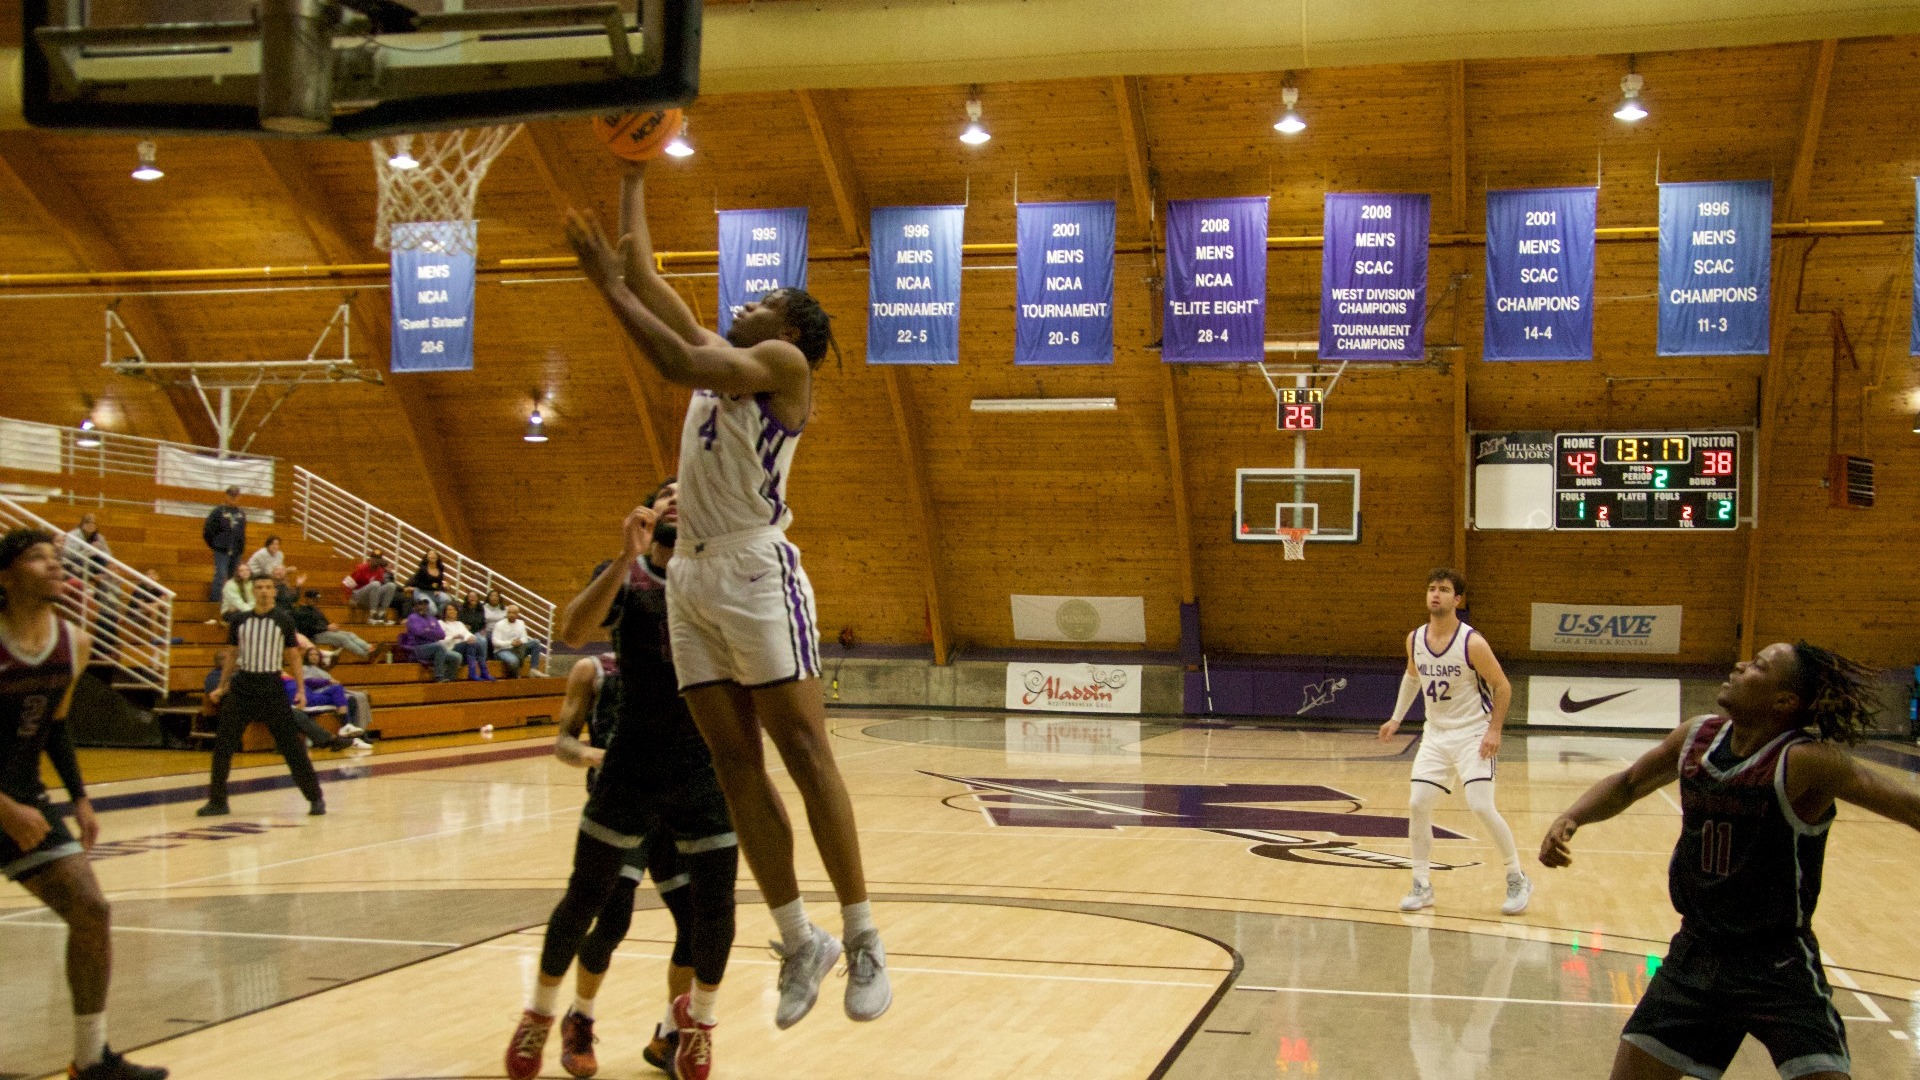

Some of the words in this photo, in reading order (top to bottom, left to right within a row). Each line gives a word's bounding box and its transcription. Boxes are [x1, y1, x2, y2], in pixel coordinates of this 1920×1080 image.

[1361, 205, 1392, 219] 2008
[1698, 201, 1730, 217] 1996
[1200, 218, 1230, 233] 2008
[1525, 211, 1556, 226] 2001
[751, 227, 777, 241] 1995
[903, 224, 930, 238] 1996
[1052, 223, 1080, 237] 2001
[1692, 229, 1736, 246] MEN'S
[1355, 232, 1396, 247] MEN'S
[1519, 239, 1561, 255] MEN'S
[745, 252, 781, 267] MEN'S
[896, 249, 934, 264] MEN'S
[1046, 248, 1085, 264] MEN'S
[1195, 245, 1235, 260] MEN'S
[417, 264, 451, 279] MEN'S
[1355, 260, 1394, 275] SCAC
[1694, 259, 1734, 275] SCAC
[1195, 273, 1233, 287] NCAA
[1520, 267, 1558, 283] SCAC
[745, 278, 779, 293] NCAA
[896, 276, 931, 290] NCAA
[1046, 276, 1083, 291] NCAA
[417, 290, 449, 304] NCAA
[1331, 288, 1364, 300] WEST
[1366, 288, 1415, 300] DIVISION
[1670, 286, 1758, 305] CHAMPIONS
[872, 302, 955, 317] TOURNAMENT
[1021, 302, 1108, 318] TOURNAMENT
[1169, 300, 1211, 316] "ELITE
[1214, 298, 1259, 314] EIGHT"
[1338, 302, 1407, 314] CHAMPIONS
[1497, 296, 1580, 312] CHAMPIONS
[1332, 324, 1411, 336] TOURNAMENT
[1523, 326, 1552, 340] 14-4
[420, 340, 445, 354] 20-6
[1336, 338, 1405, 350] CHAMPIONS
[1285, 406, 1314, 429] 26
[698, 405, 718, 451] 4
[1503, 443, 1554, 452] MILLSAPS
[1563, 438, 1595, 449] HOME
[1690, 437, 1735, 448] VISITOR
[1506, 451, 1550, 459] MAJORS
[1702, 451, 1732, 474] 38
[1567, 453, 1596, 475] 42
[1576, 478, 1602, 487] BONUS
[1622, 472, 1653, 481] PERIOD
[1654, 469, 1668, 488] 2
[1689, 477, 1717, 486] BONUS
[1561, 492, 1585, 501] FOULS
[1617, 492, 1647, 501] PLAYER
[1654, 492, 1680, 501] FOULS
[1707, 492, 1733, 500] FOULS
[1579, 501, 1584, 519] 1
[1599, 506, 1608, 519] 2
[1682, 506, 1692, 519] 2
[1719, 500, 1732, 519] 2
[1595, 520, 1610, 528] TOL
[1679, 520, 1694, 528] TOL
[1558, 613, 1657, 637] U-SAVE
[1417, 664, 1461, 677] MILLSAPS
[1022, 675, 1112, 705] Aladdin
[1426, 680, 1451, 703] 42
[1702, 819, 1732, 877] 11
